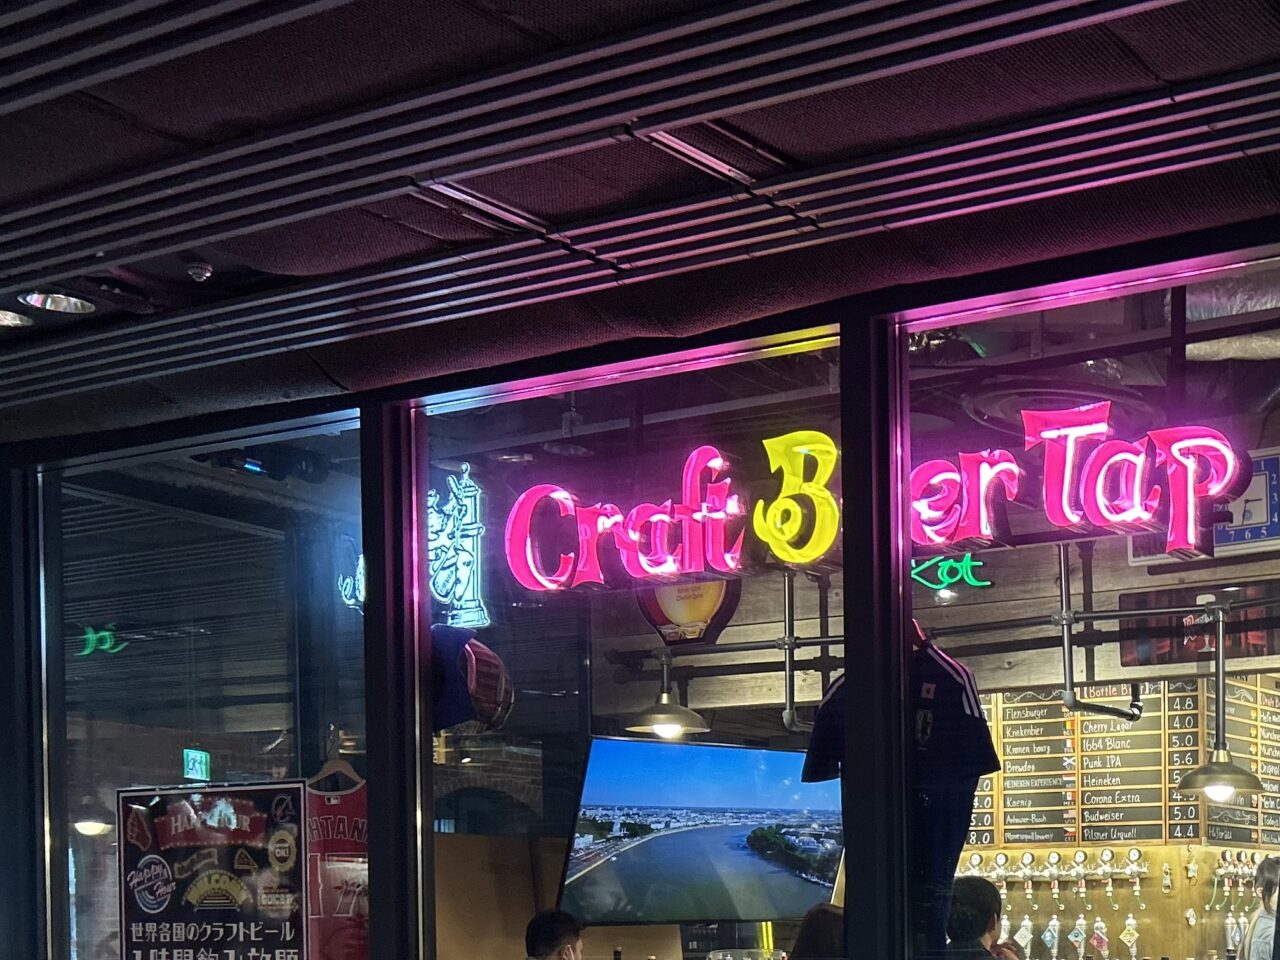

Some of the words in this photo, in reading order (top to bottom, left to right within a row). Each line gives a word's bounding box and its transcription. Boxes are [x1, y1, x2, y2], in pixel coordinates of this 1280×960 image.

[1261, 460, 1266, 471] 1
[1272, 474, 1278, 485] 2
[1272, 494, 1278, 504] 3
[506, 444, 744, 591] Craft
[754, 431, 1020, 563] Ber
[1272, 513, 1279, 523] 4
[1229, 531, 1235, 542] 7
[1245, 529, 1251, 539] 6
[1261, 528, 1268, 538] 5
[1173, 697, 1194, 711] 4.8
[1083, 720, 1107, 734] Cherry
[1173, 716, 1194, 730] 4.0
[1083, 739, 1103, 752] 1664
[1106, 737, 1130, 751] Blanc
[1172, 735, 1193, 748] 5.0
[1083, 755, 1102, 768] Punk
[1107, 755, 1121, 767] IPA
[1173, 753, 1193, 766] 5.6
[1083, 774, 1121, 787] Heineken
[1084, 793, 1112, 804] Corona
[1115, 791, 1140, 803] Extra
[970, 814, 991, 826] 5.0
[1084, 810, 1124, 822] Budweiser
[1174, 807, 1195, 820] 5.0
[307, 814, 368, 845] HTAN
[1084, 828, 1109, 841] Pilsner
[1174, 825, 1194, 838] 4.4
[969, 831, 991, 844] 8.0
[127, 862, 164, 890] Happy
[153, 881, 176, 899] Hour
[131, 921, 295, 943] 世界各国のクラフトビール
